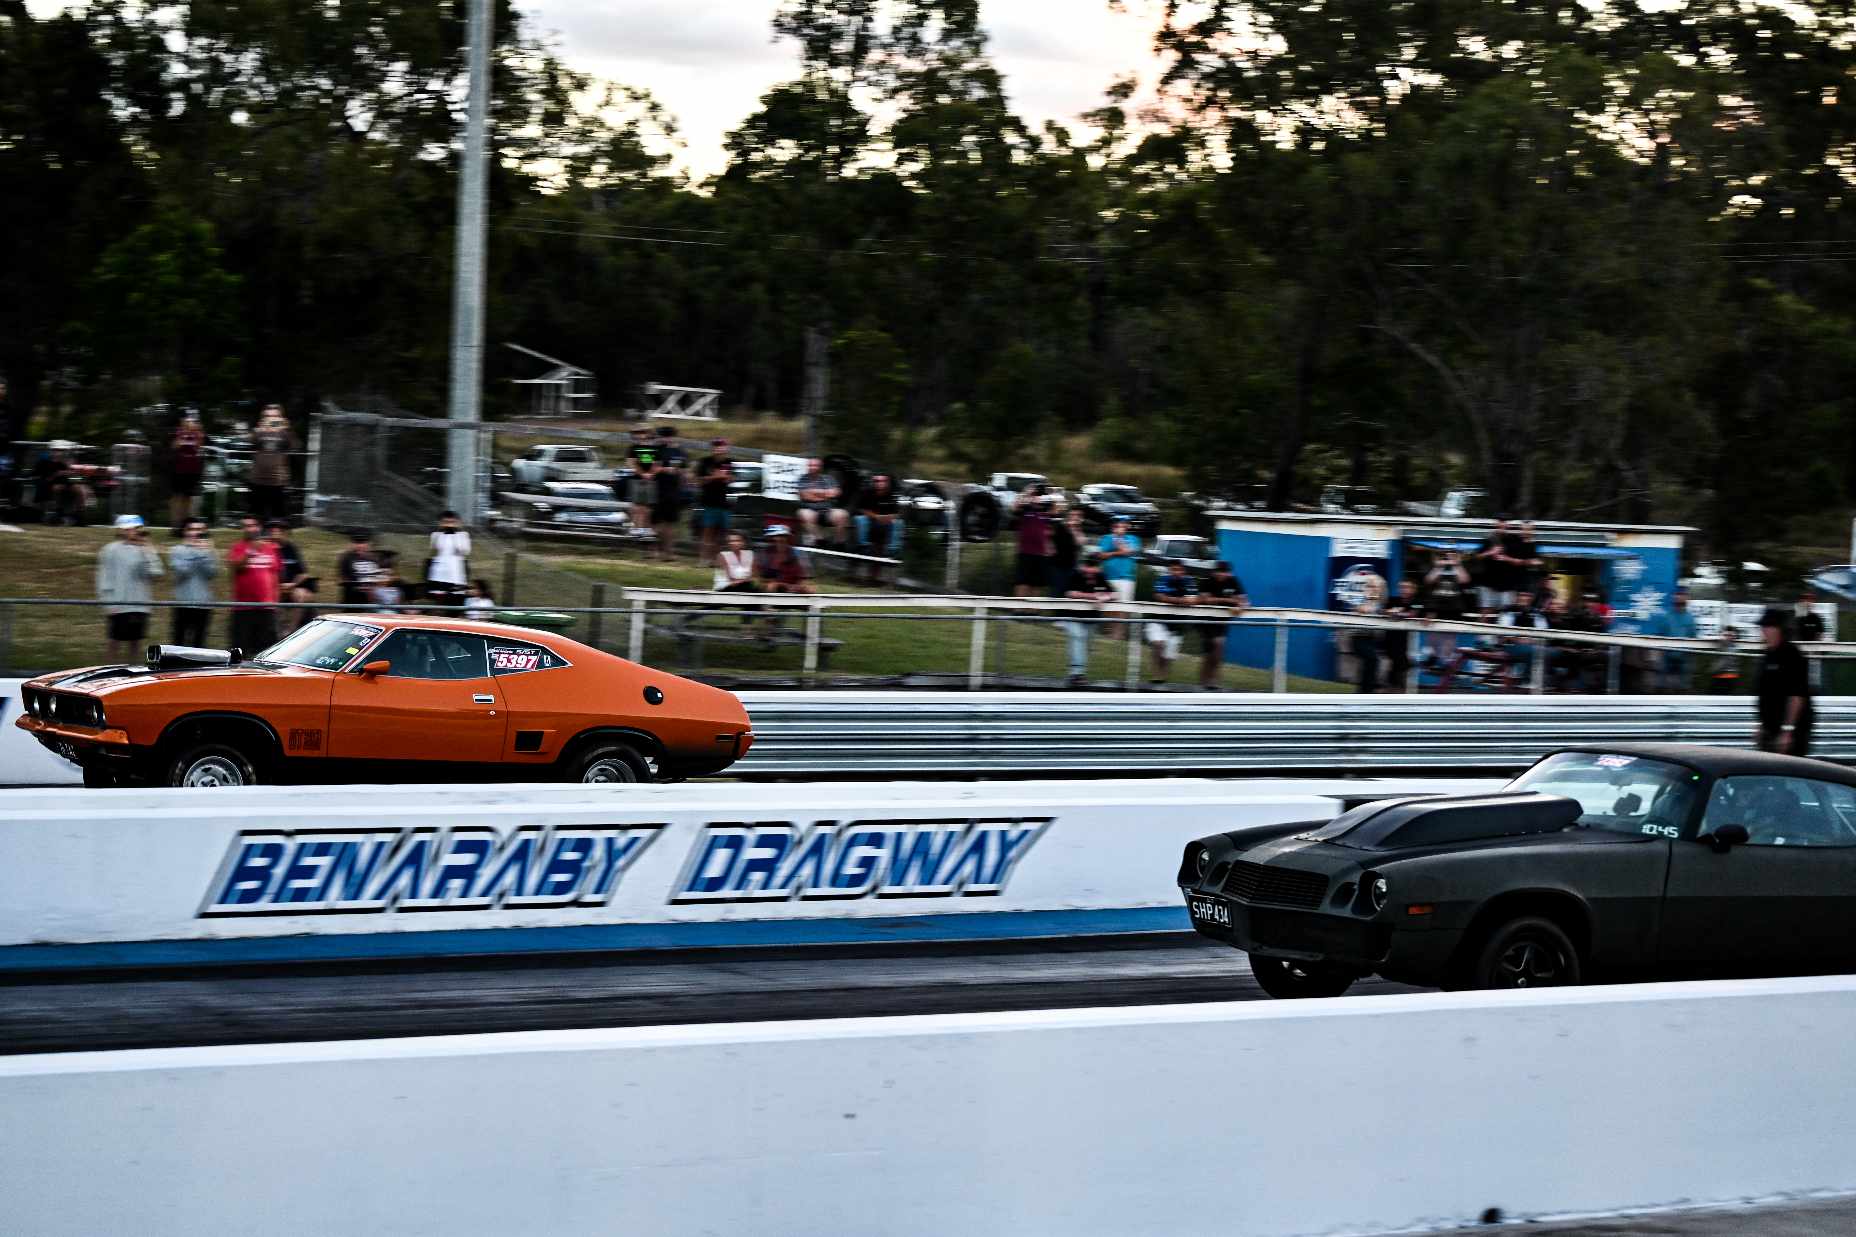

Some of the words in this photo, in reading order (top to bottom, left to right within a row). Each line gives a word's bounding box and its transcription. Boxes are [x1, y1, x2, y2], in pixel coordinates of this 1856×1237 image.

[497, 653, 538, 669] 5397
[198, 824, 665, 916] BENARABY
[670, 818, 1051, 903] DRAGWAY
